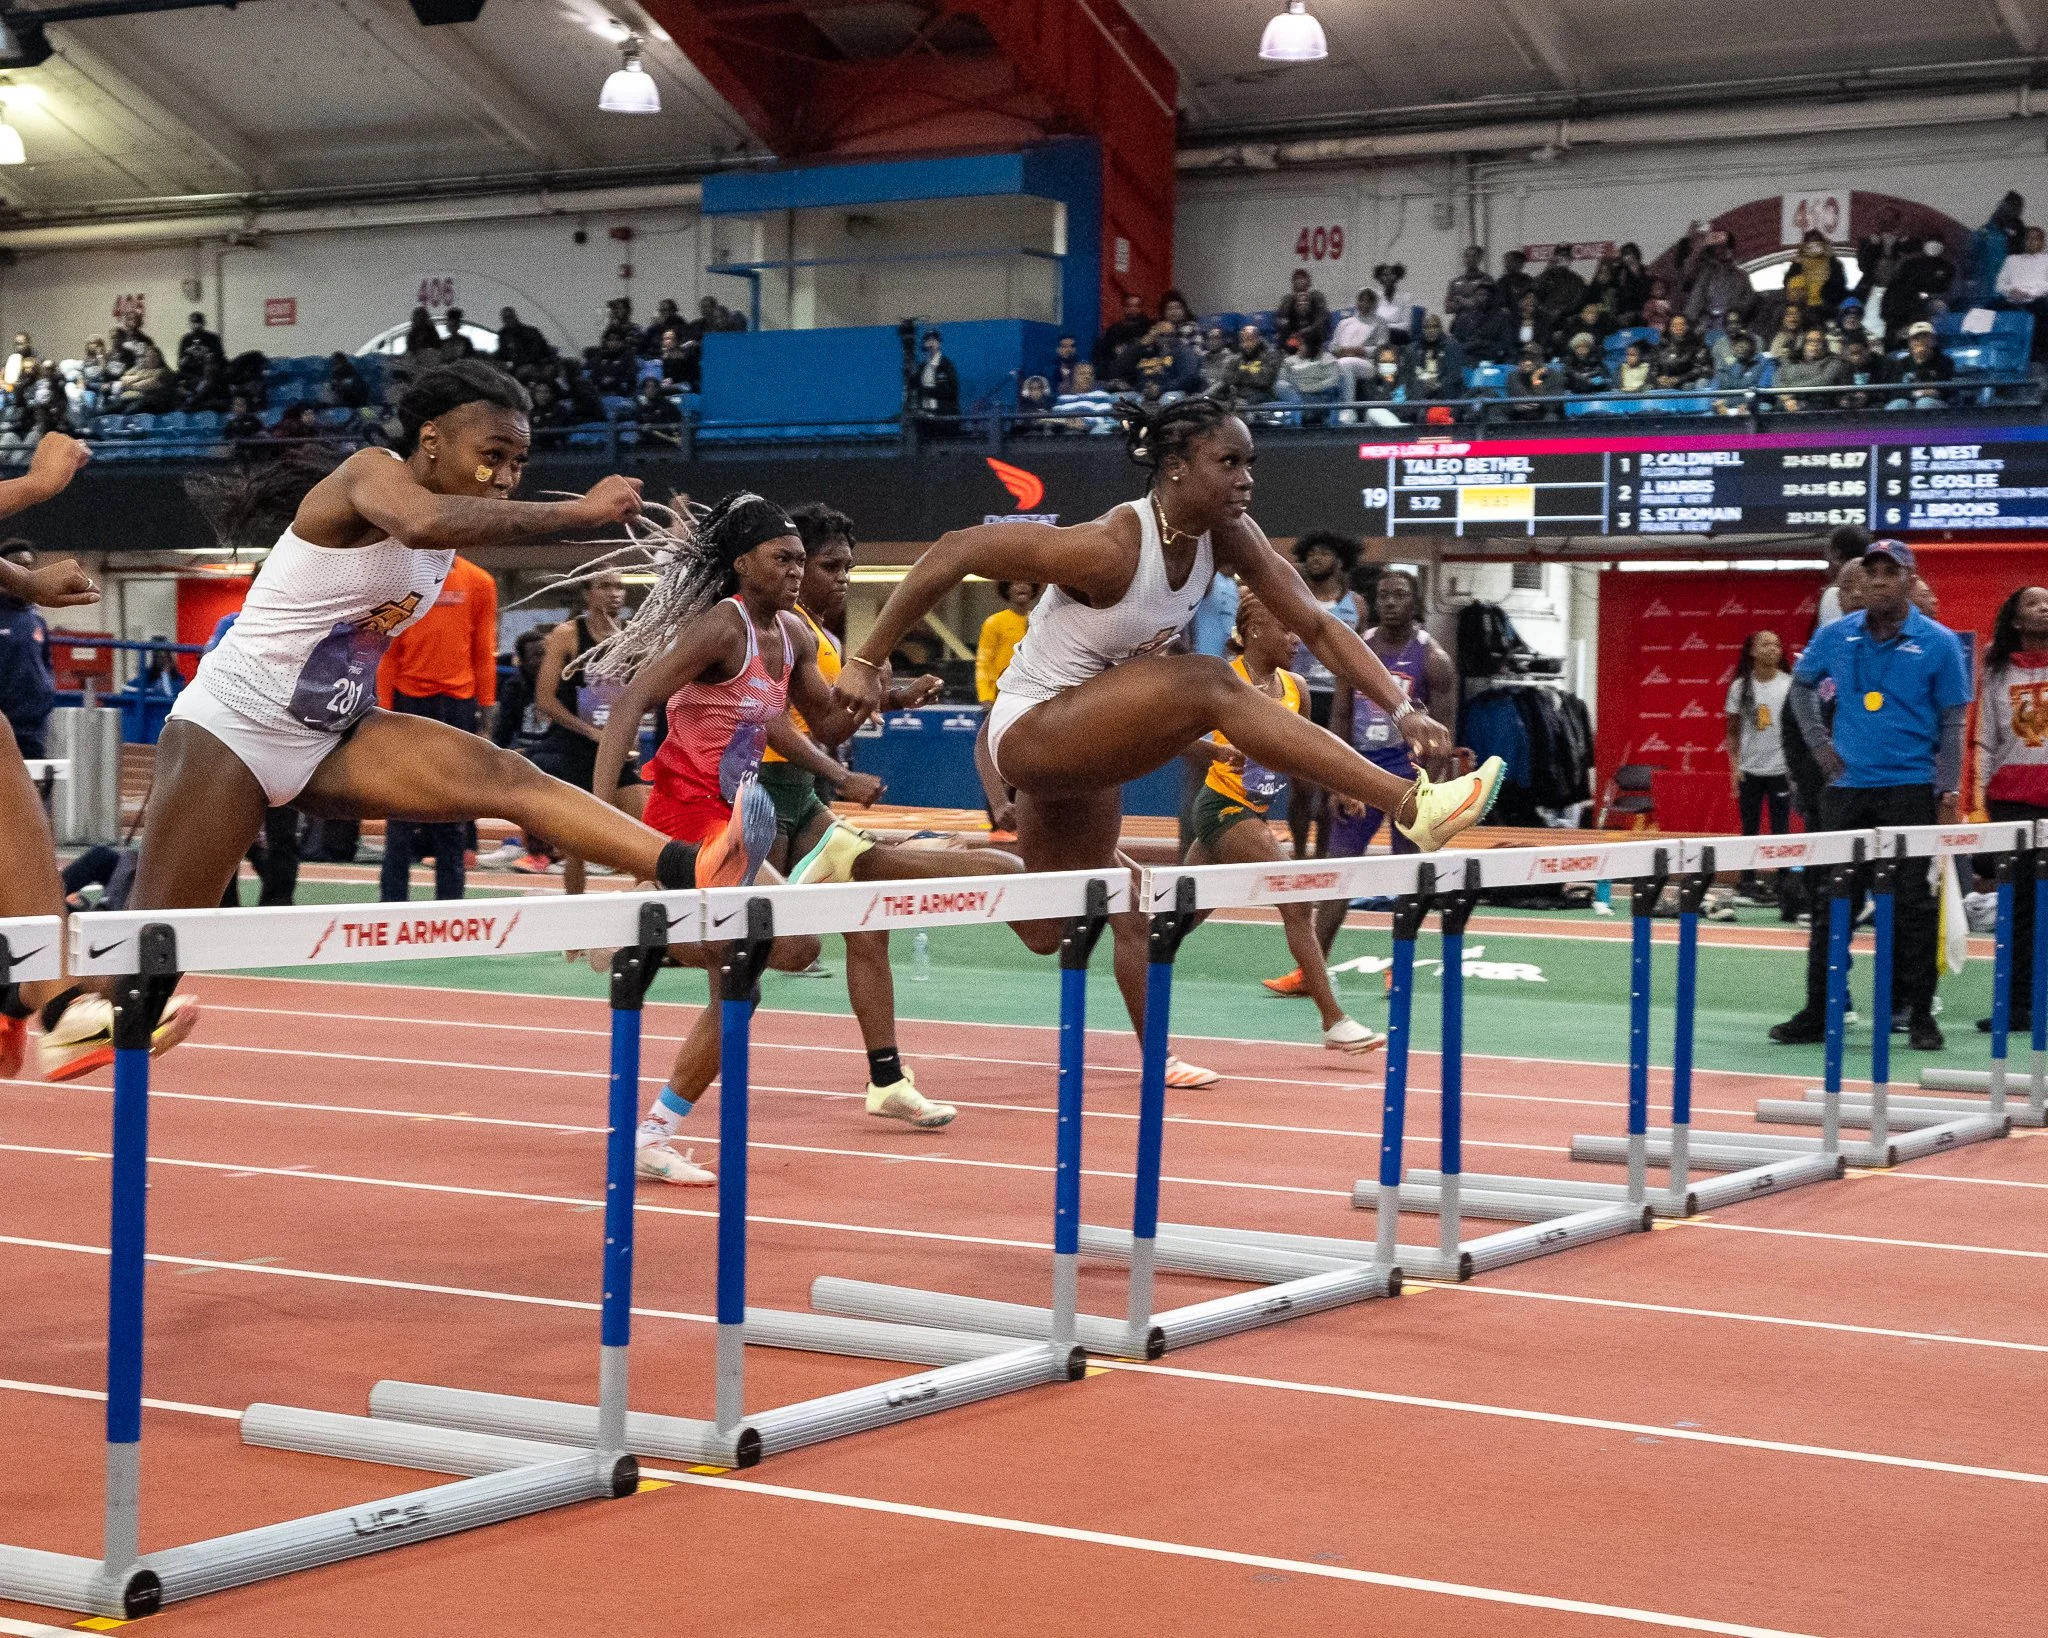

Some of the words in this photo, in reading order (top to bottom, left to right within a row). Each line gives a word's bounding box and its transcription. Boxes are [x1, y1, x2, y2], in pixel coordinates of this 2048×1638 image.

[1296, 225, 1344, 260] 409
[1657, 452, 1744, 466] CALDWELL
[1829, 452, 1867, 468] 6.87
[1887, 451, 1902, 467] 4
[1930, 445, 1982, 459] WEST
[1403, 458, 1464, 474] TALEO
[1465, 457, 1535, 473] BETHEL
[1620, 458, 1630, 472] 1
[1655, 480, 1715, 493] HARRIS
[1828, 481, 1867, 497] 6.86
[1887, 480, 1901, 496] 5
[1930, 474, 1999, 488] GOSLEE
[1362, 488, 1388, 508] 19
[1618, 485, 1632, 501] 2
[1828, 509, 1867, 525] 6.75
[1886, 508, 1901, 524] 6
[1927, 502, 2000, 517] BROOKS
[1618, 512, 1631, 528] 3
[883, 896, 915, 916] THE
[918, 891, 988, 914] ARMORY
[341, 922, 391, 947] THE
[395, 917, 496, 945] ARMORY
